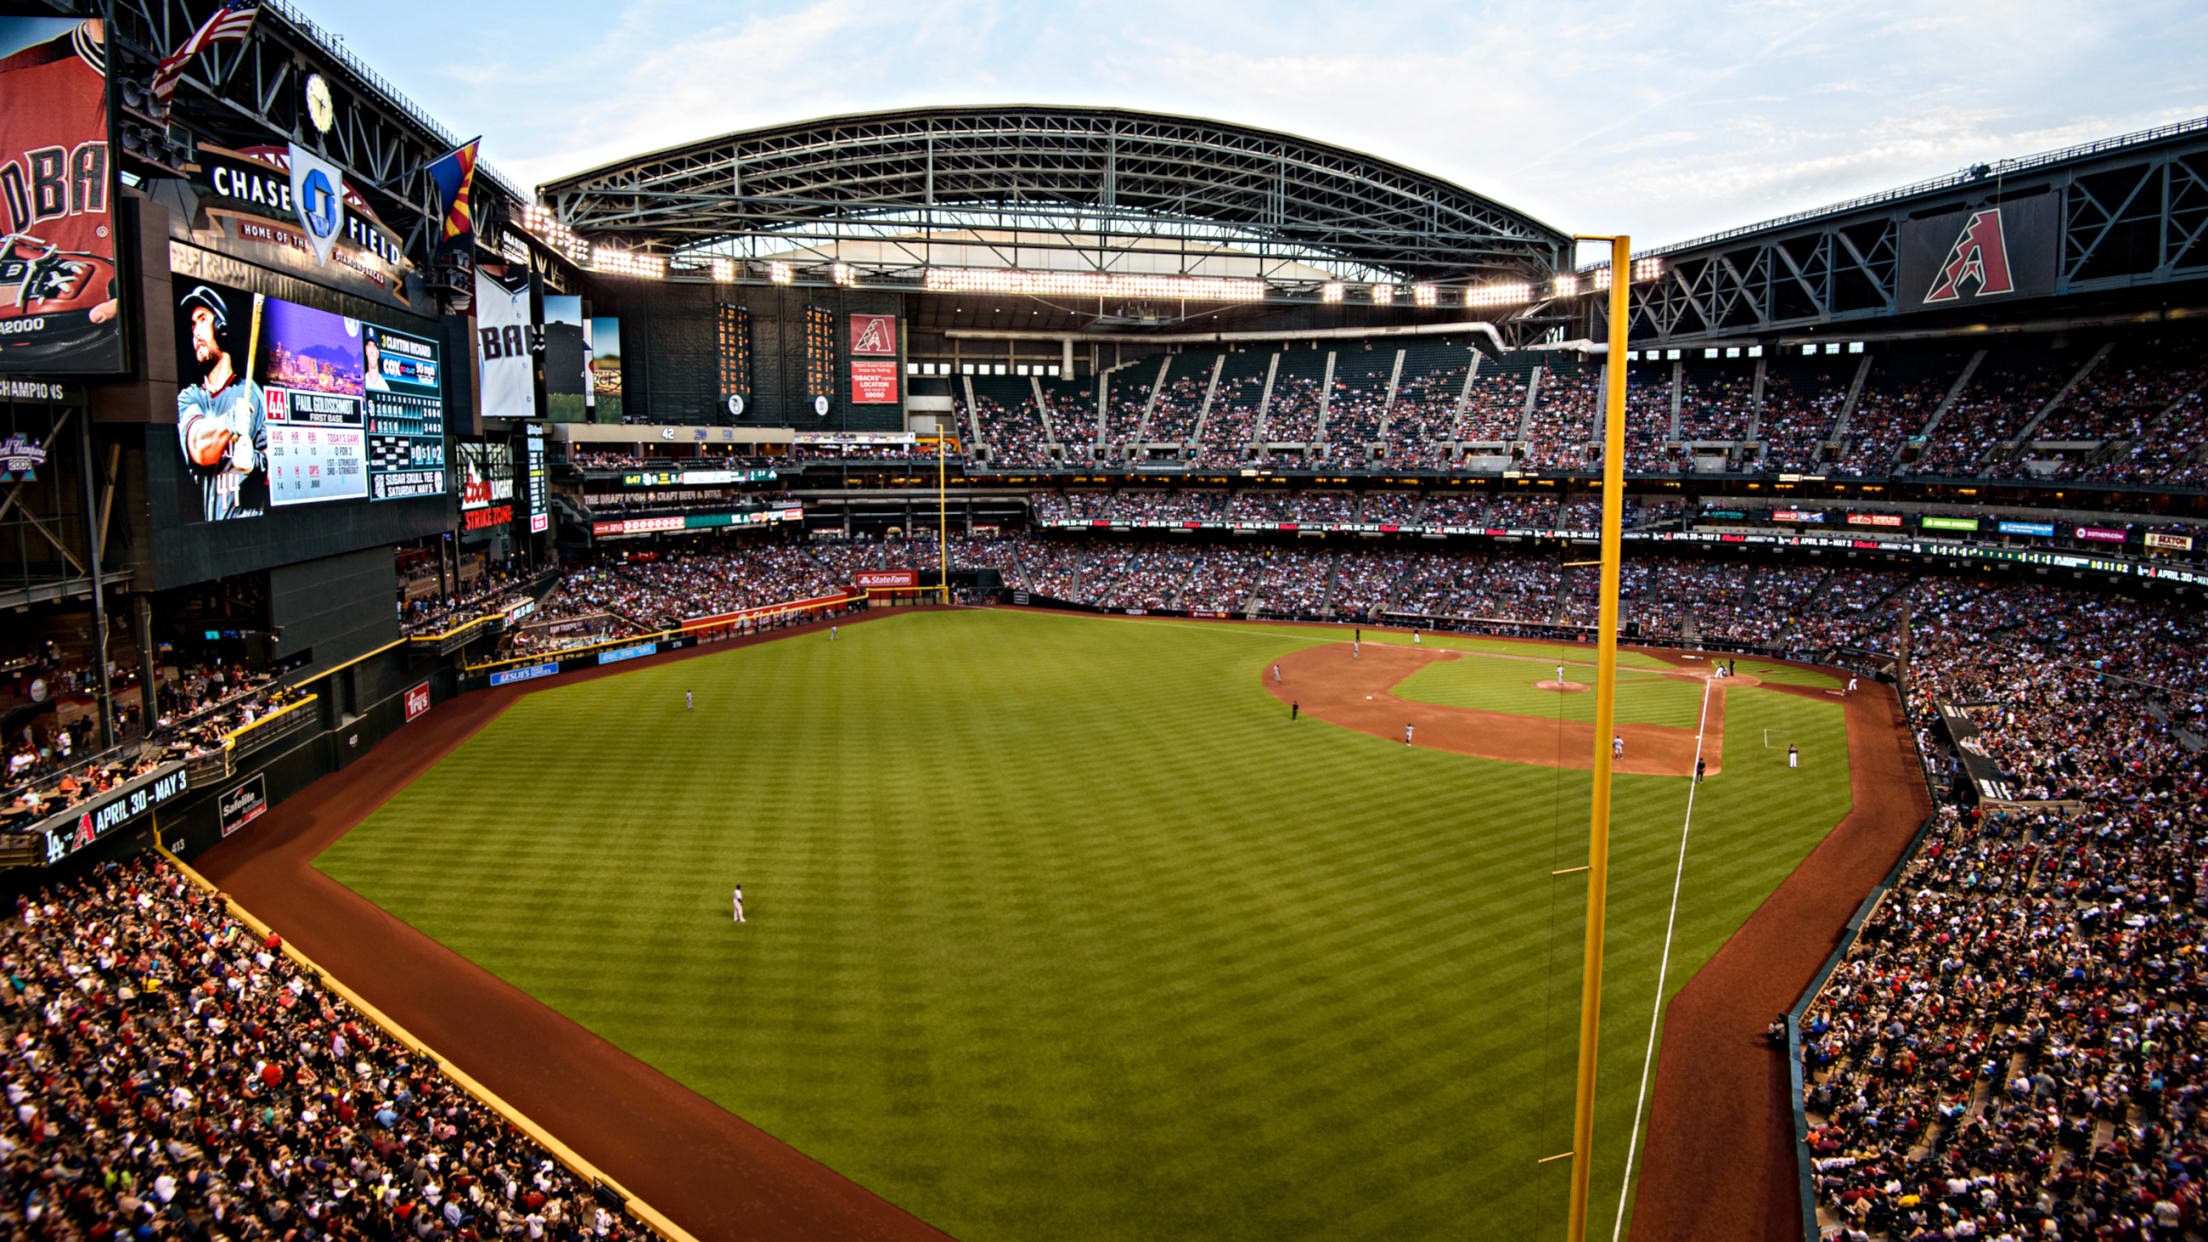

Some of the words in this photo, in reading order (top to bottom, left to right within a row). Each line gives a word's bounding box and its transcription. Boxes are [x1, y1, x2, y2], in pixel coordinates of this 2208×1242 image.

[213, 166, 291, 211] CHASE
[349, 216, 400, 266] FIELD
[243, 224, 271, 239] HOME
[276, 231, 287, 243] OF
[383, 358, 402, 376] COX
[269, 392, 284, 418] 44
[328, 414, 344, 423] BASE
[661, 428, 674, 440] 42
[423, 472, 433, 482] TEE
[216, 472, 240, 511] 44
[492, 479, 513, 500] LIGHT
[584, 494, 599, 505] THE
[600, 494, 624, 504] DRAFT
[625, 492, 646, 502] ROOM
[657, 491, 678, 501] CRAFT
[679, 491, 696, 500] BEER
[465, 508, 492, 531] STRIKE
[493, 505, 512, 526] ZONE
[2158, 536, 2187, 545] SEXTON
[2157, 569, 2179, 580] APRIL
[2181, 572, 2192, 582] 30
[96, 799, 130, 834] APRIL
[130, 789, 147, 814] 30
[154, 774, 177, 802] MAY
[178, 769, 187, 790] 3
[223, 792, 255, 817] Safelite
